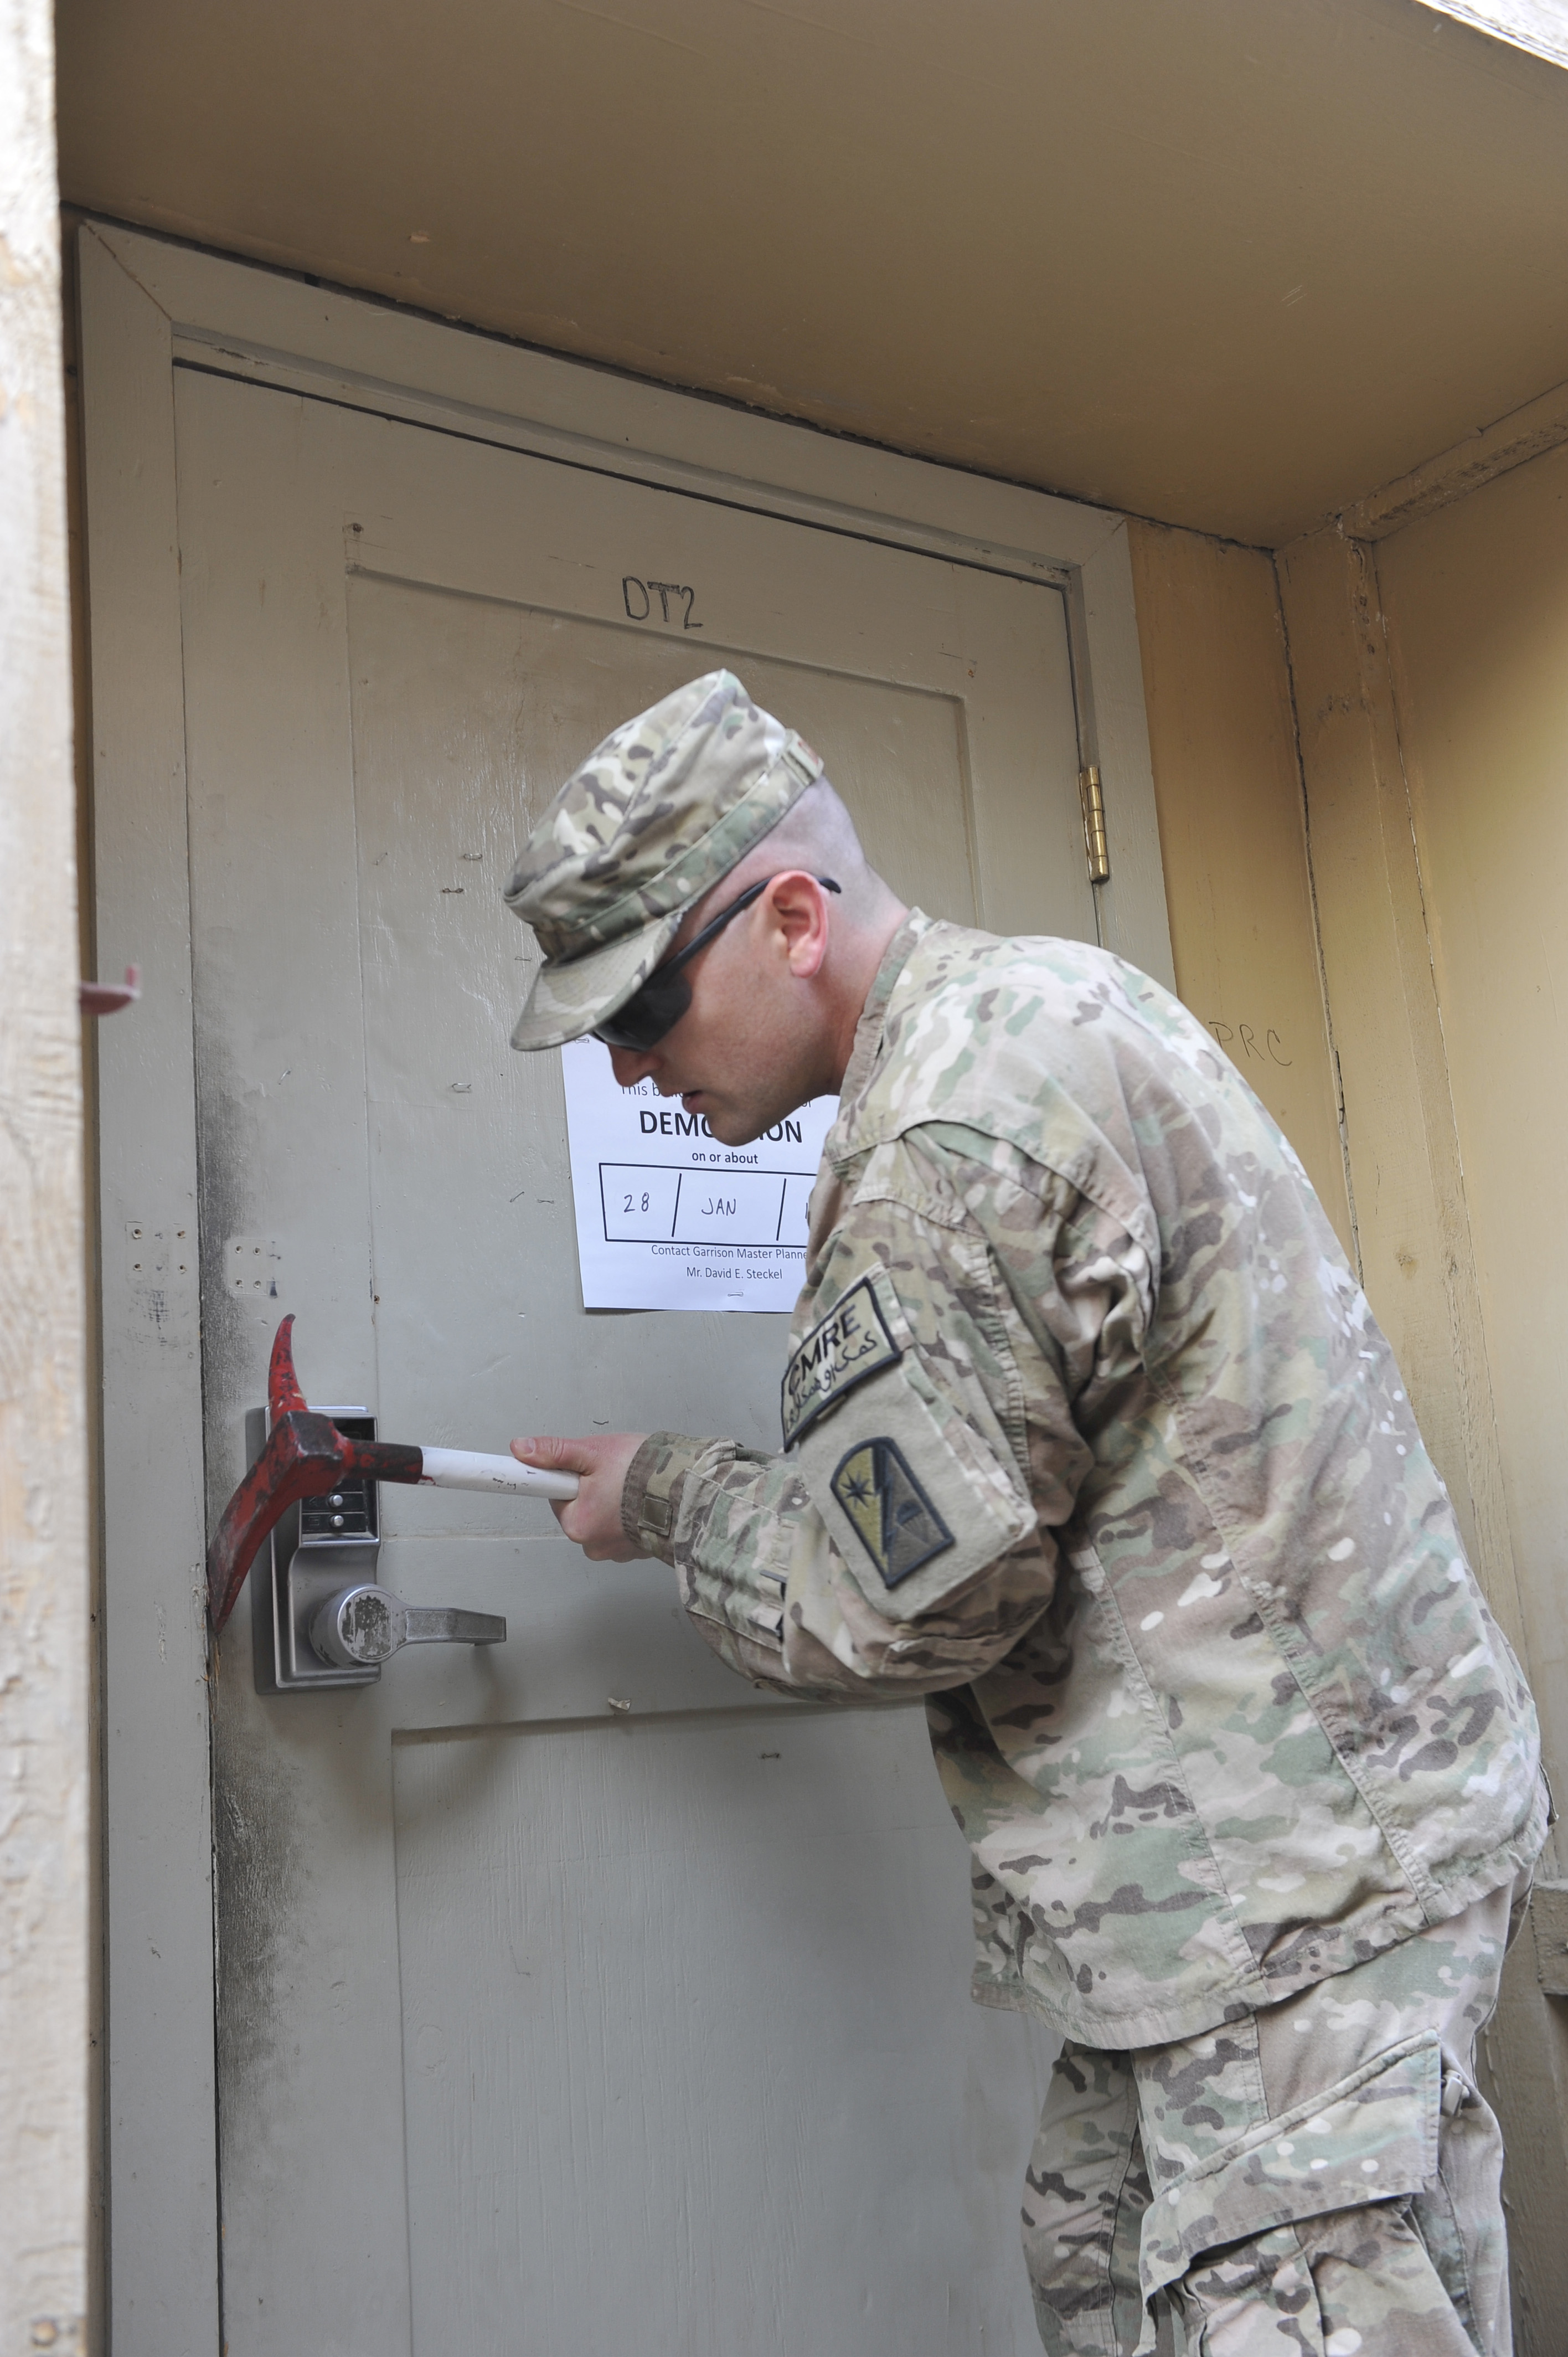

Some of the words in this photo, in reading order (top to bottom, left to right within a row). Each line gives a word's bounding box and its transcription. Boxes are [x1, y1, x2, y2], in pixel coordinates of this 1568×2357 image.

[622, 576, 704, 630] DT2
[1209, 1021, 1292, 1066] PRC
[639, 1110, 802, 1143] DEMOON
[692, 1152, 706, 1162] on
[709, 1153, 721, 1162] or
[724, 1151, 759, 1164] about
[623, 1192, 649, 1213] 28
[701, 1197, 736, 1216] JAN
[651, 1244, 690, 1257] Contact
[693, 1246, 734, 1259] Garrison
[736, 1248, 773, 1259] Master
[776, 1248, 807, 1259] Planne
[687, 1266, 703, 1278] Mr.
[705, 1267, 731, 1279] David
[735, 1268, 744, 1279] E.
[746, 1268, 782, 1280] Steckel
